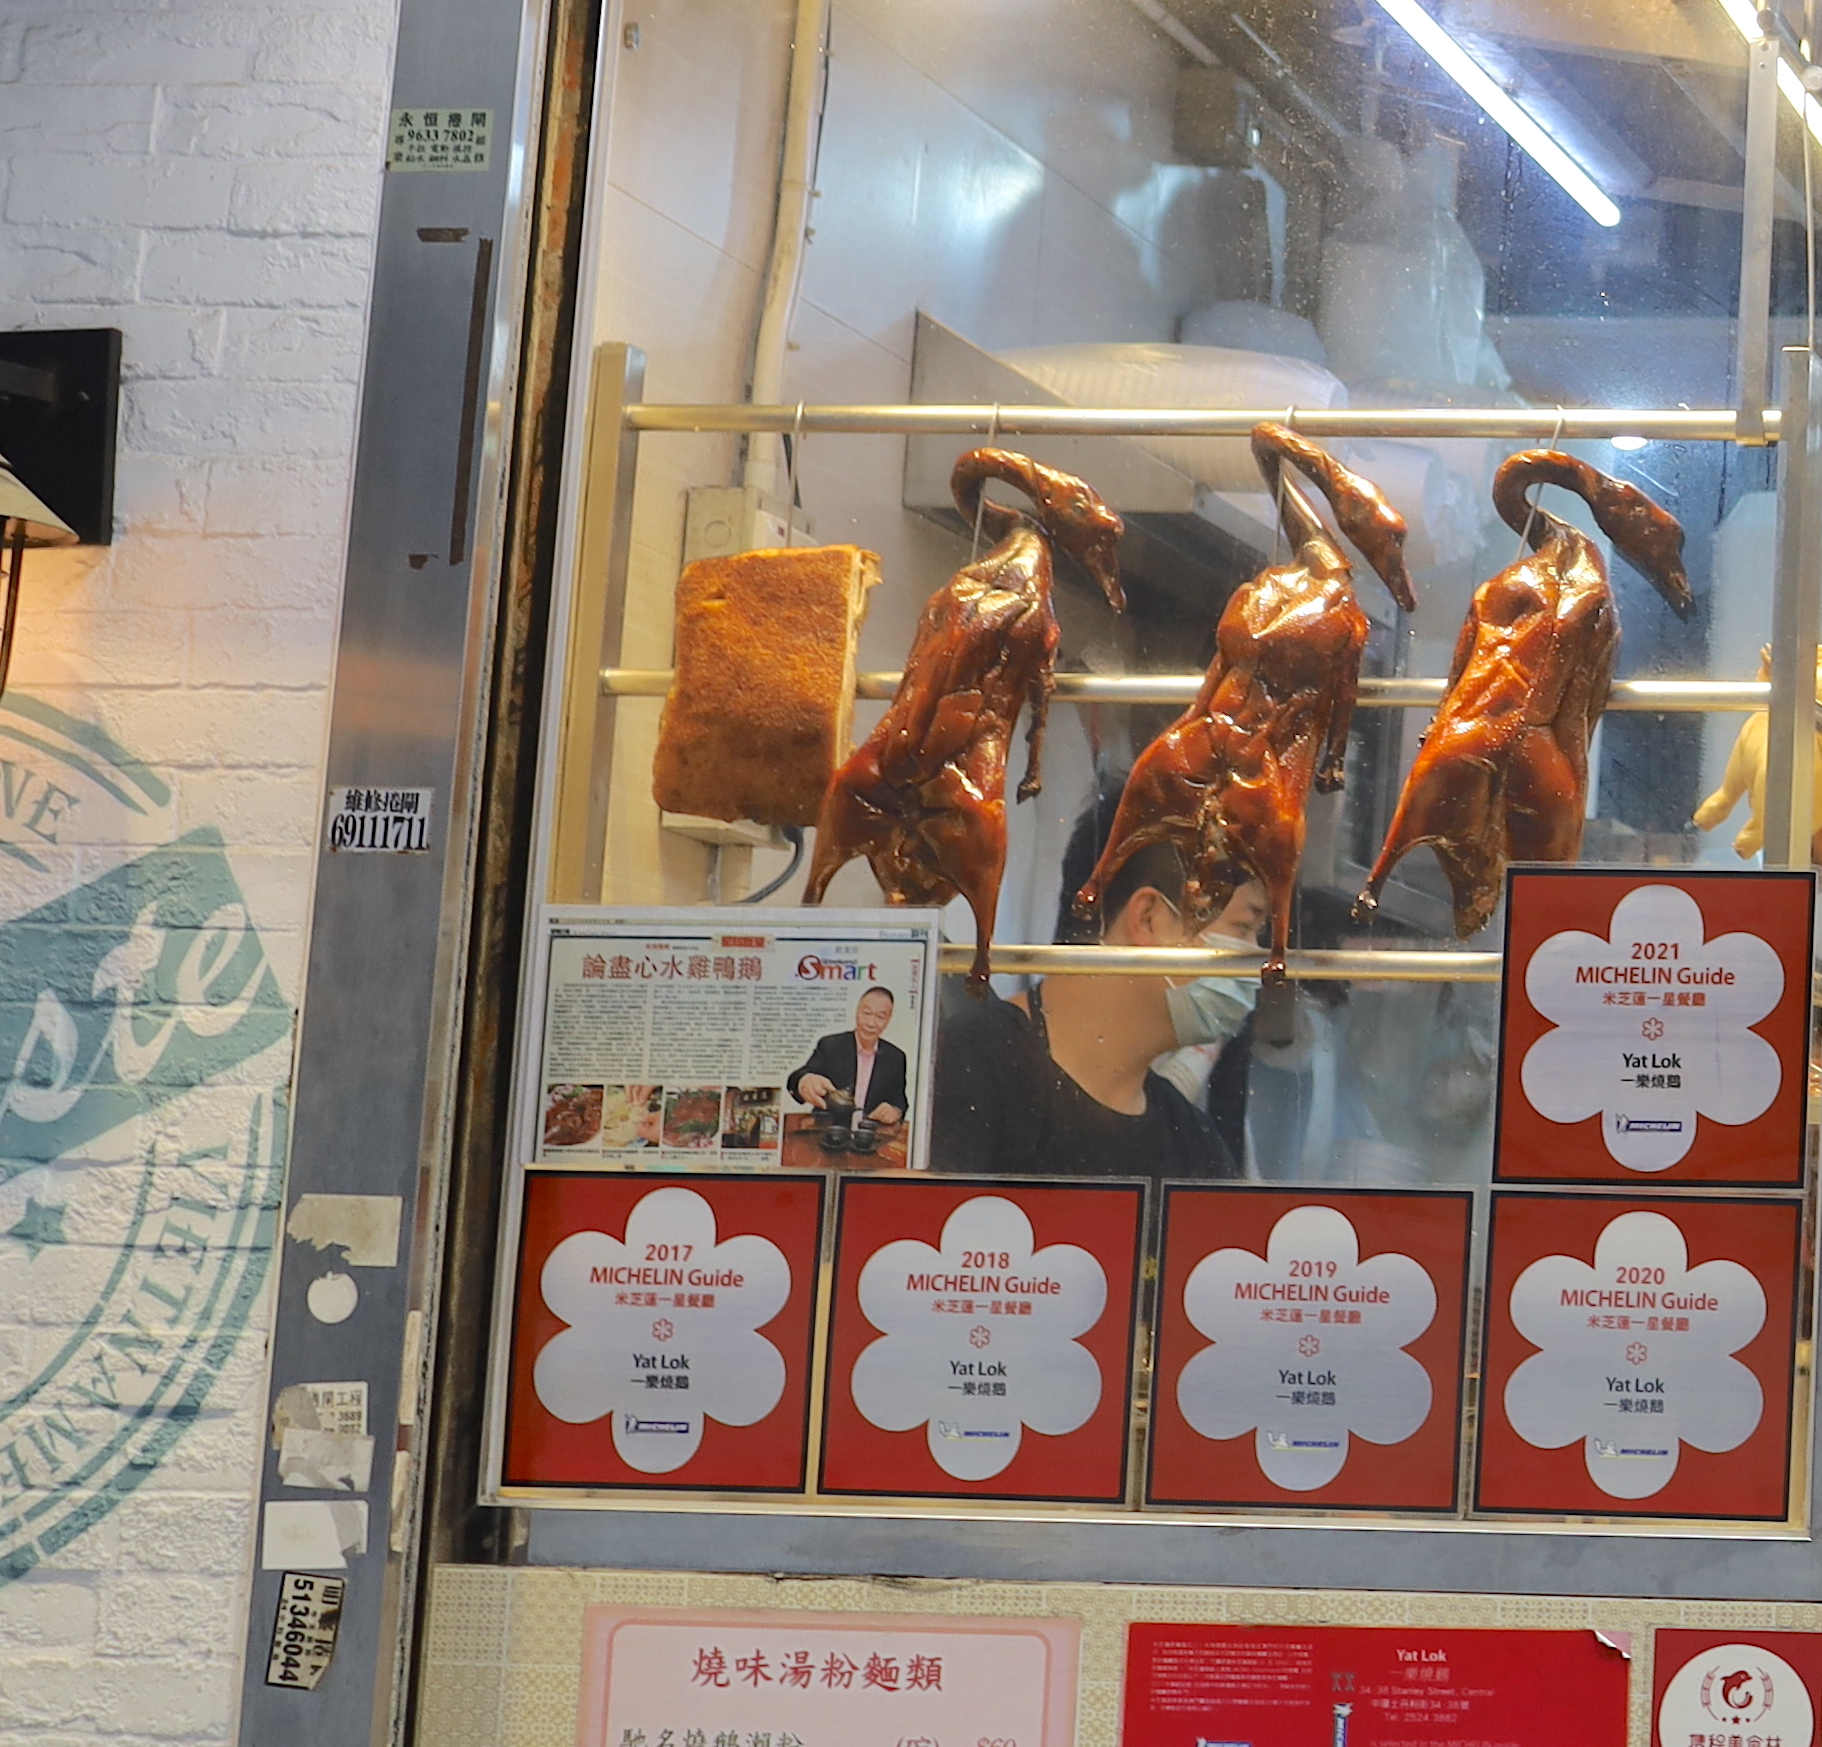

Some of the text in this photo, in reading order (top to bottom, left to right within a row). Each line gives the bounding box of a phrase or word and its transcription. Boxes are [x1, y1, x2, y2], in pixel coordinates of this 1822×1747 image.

[331, 814, 426, 850] 69111711
[1631, 942, 1680, 960] 2021
[582, 954, 763, 981] 論盡心水雞鴨鵝
[1575, 967, 1735, 987] MICHELIN Guide
[1622, 1053, 1682, 1069] Yat Lok
[644, 1244, 693, 1262] 2017
[961, 1252, 1010, 1269] 2018
[589, 1268, 744, 1289] MICHELIN Guide
[1289, 1261, 1337, 1278] 2019
[1615, 1267, 1665, 1284] 2020
[906, 1275, 1000, 1294] MICHELIN
[1234, 1284, 1328, 1303] MICHELIN
[1559, 1290, 1656, 1309] MICHELIN
[633, 1354, 690, 1370] Yat Lok
[279, 1578, 314, 1682] 51346044
[1396, 1649, 1447, 1662] Yat Lok
[691, 1648, 944, 1692] 燒味湯粉麵類
